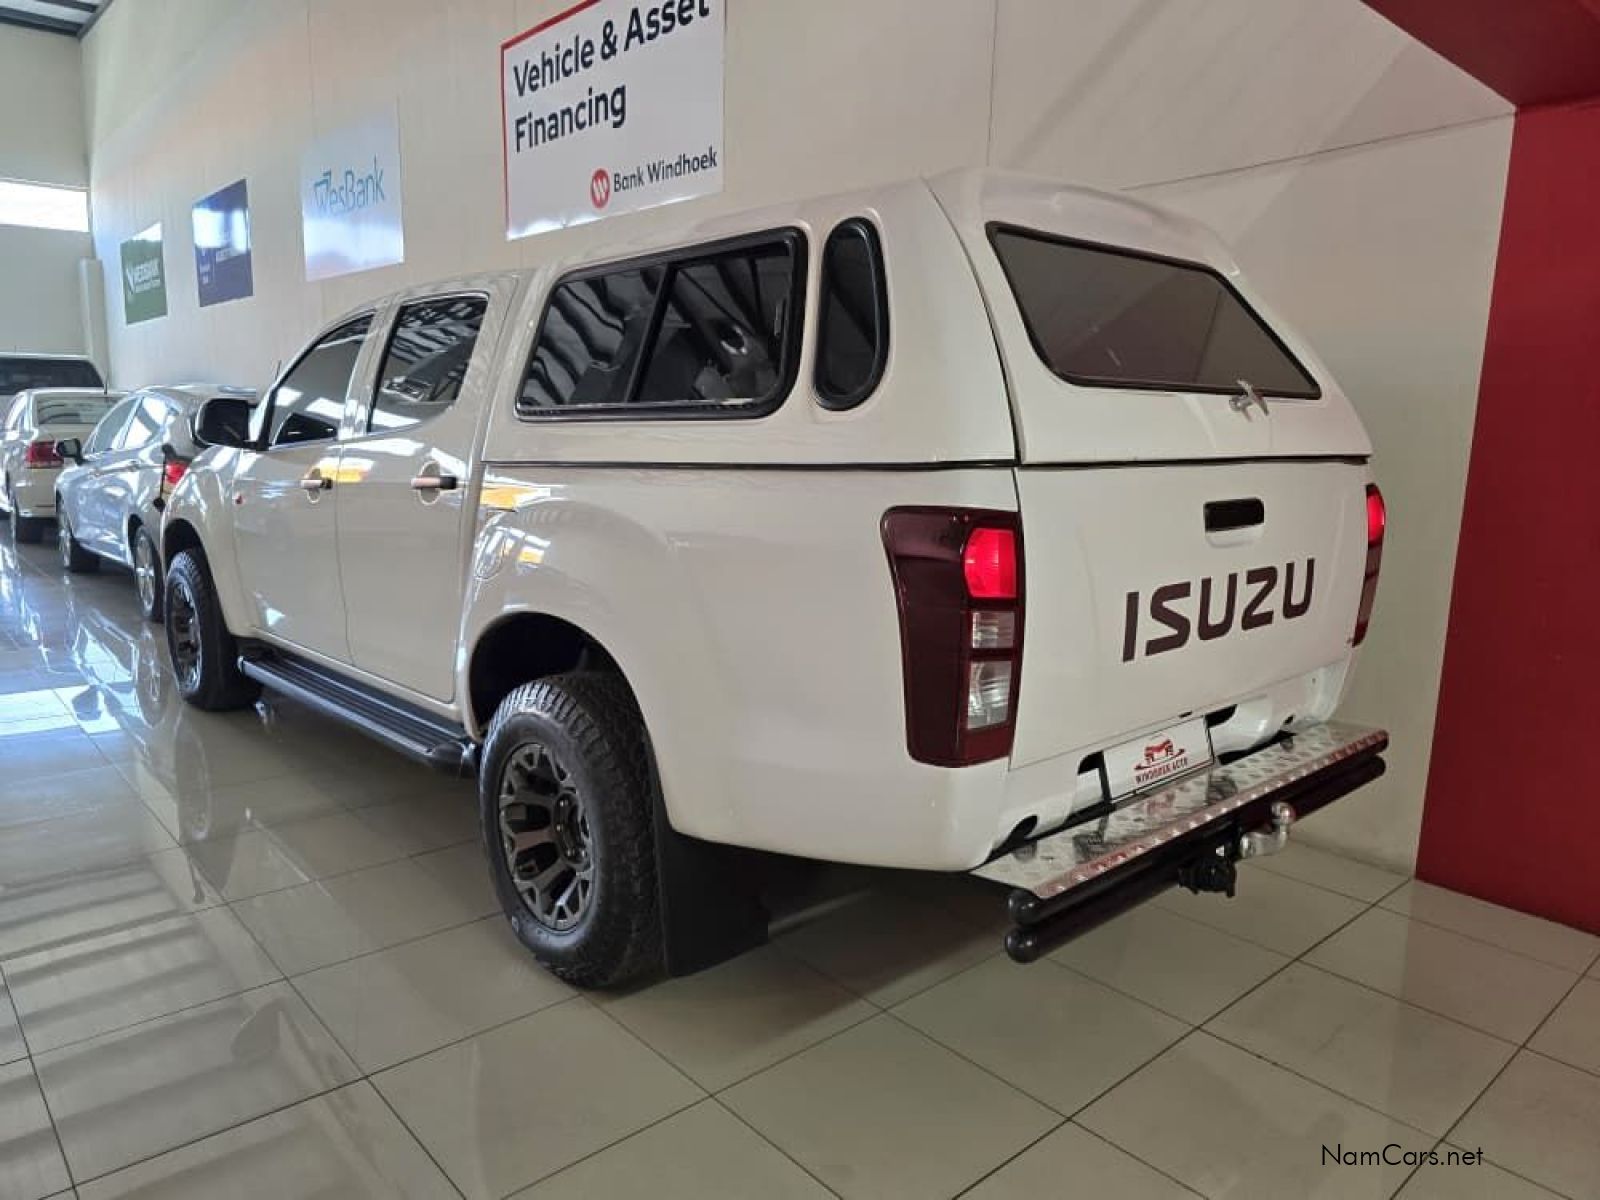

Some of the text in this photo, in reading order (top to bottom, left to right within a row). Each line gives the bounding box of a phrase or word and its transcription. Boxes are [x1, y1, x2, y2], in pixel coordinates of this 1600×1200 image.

[513, 35, 594, 97] Vehicle
[600, 20, 617, 60] &
[515, 84, 626, 153] Financing
[613, 146, 717, 192] Bank Windhoek
[1122, 557, 1315, 663] ISUZU
